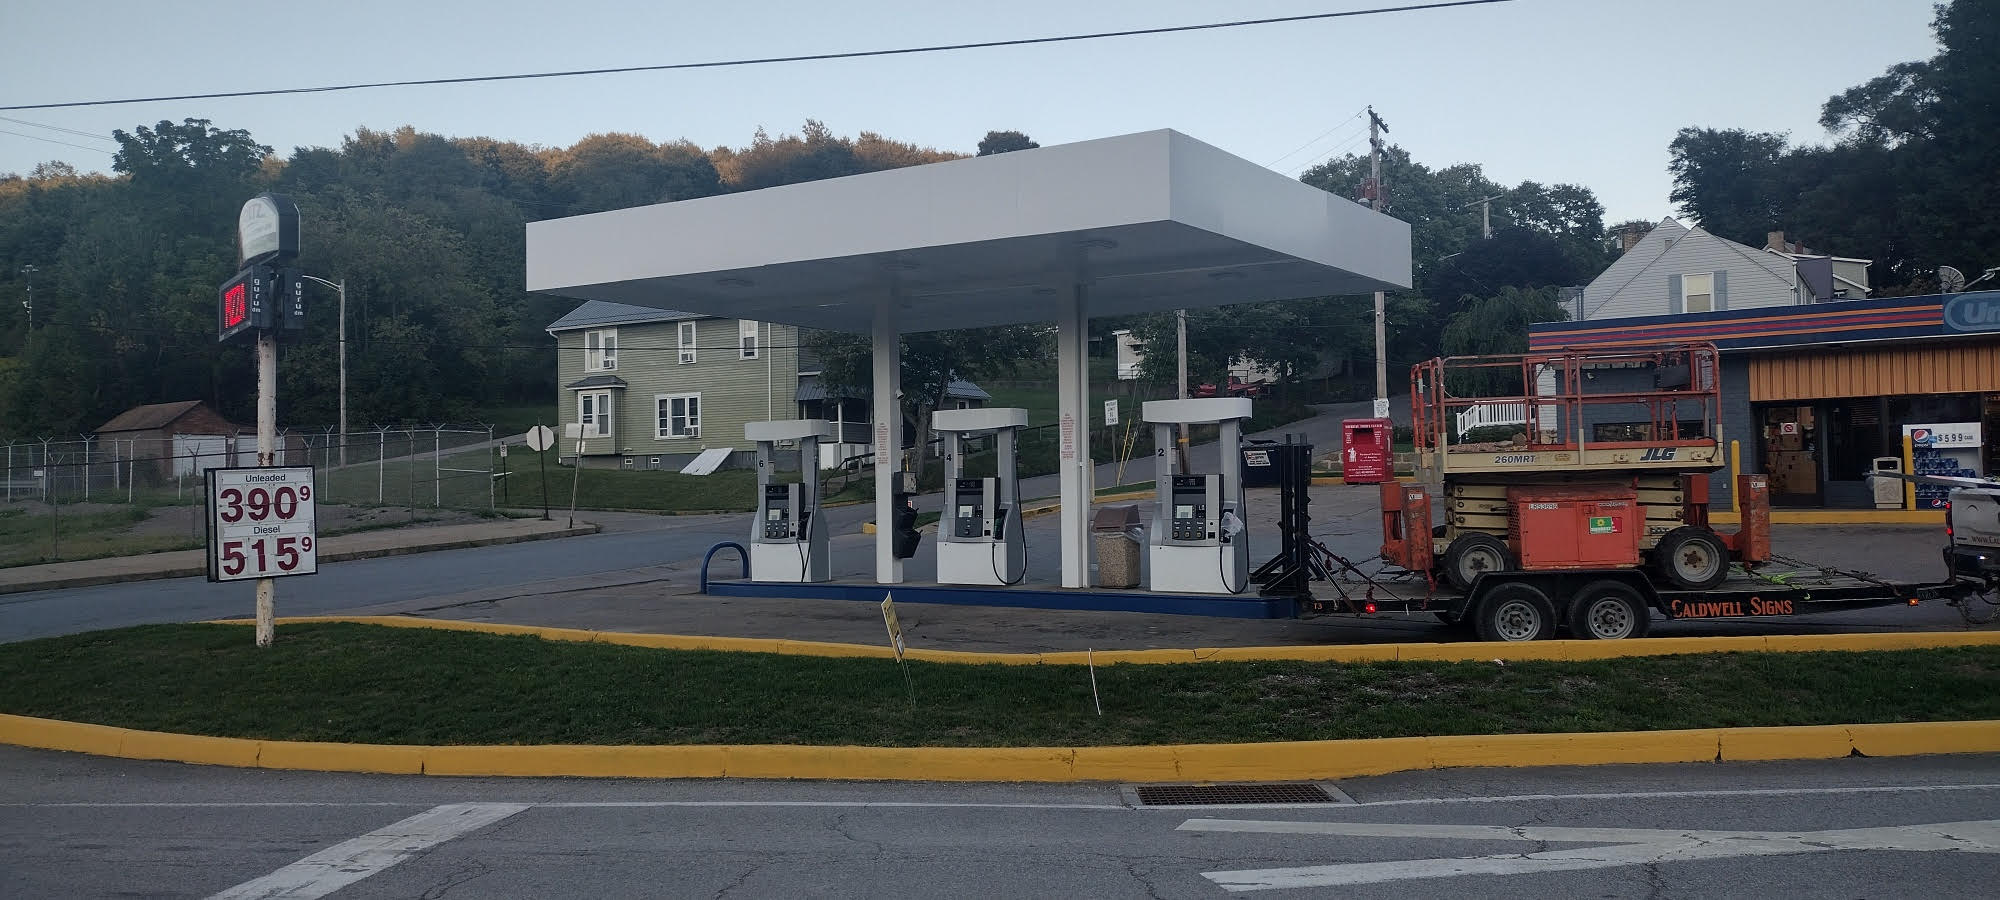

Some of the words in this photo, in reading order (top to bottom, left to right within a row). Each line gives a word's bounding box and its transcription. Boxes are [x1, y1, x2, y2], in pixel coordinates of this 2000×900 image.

[1158, 448, 1165, 457] 2
[1639, 447, 1678, 462] JLG
[946, 453, 952, 462] 4
[1494, 455, 1536, 464] 260MRT
[759, 459, 764, 468] 6
[245, 473, 286, 483] Unleaded
[253, 525, 281, 534] Diesel
[1671, 599, 1745, 618] CALDWELL
[1750, 596, 1793, 616] SIGNS
